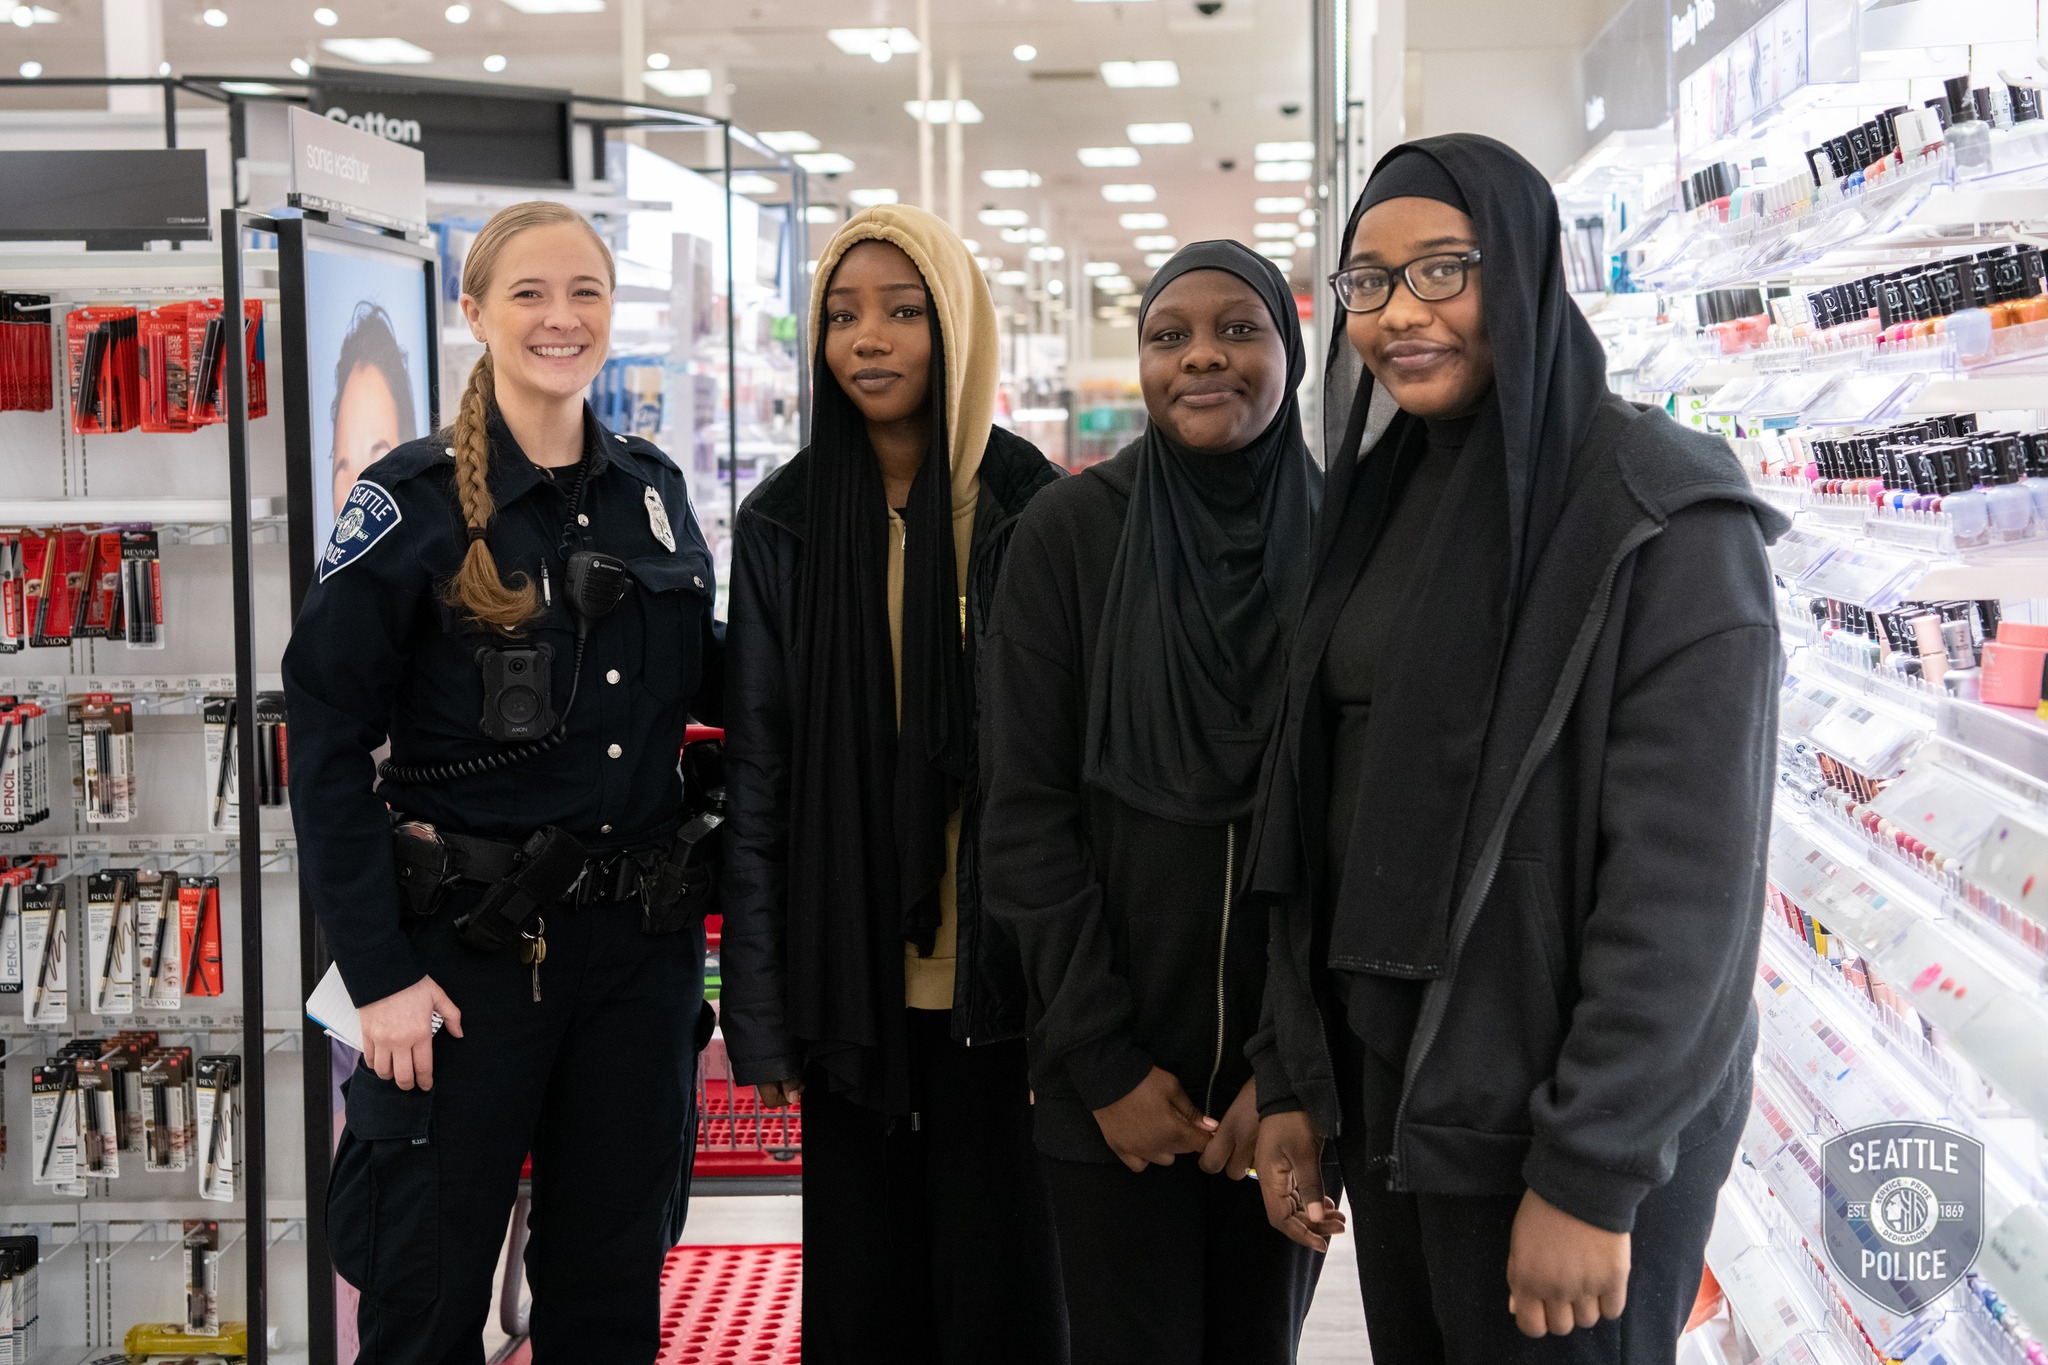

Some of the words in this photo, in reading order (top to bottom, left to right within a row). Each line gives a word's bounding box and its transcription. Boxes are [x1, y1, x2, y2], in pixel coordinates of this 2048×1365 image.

[349, 485, 393, 522] SEATTLE
[124, 549, 157, 557] REVLON
[257, 713, 283, 721] EVLON
[4, 769, 15, 816] PENCIL
[24, 762, 33, 808] PENCIL
[6, 930, 18, 977] PENCIL
